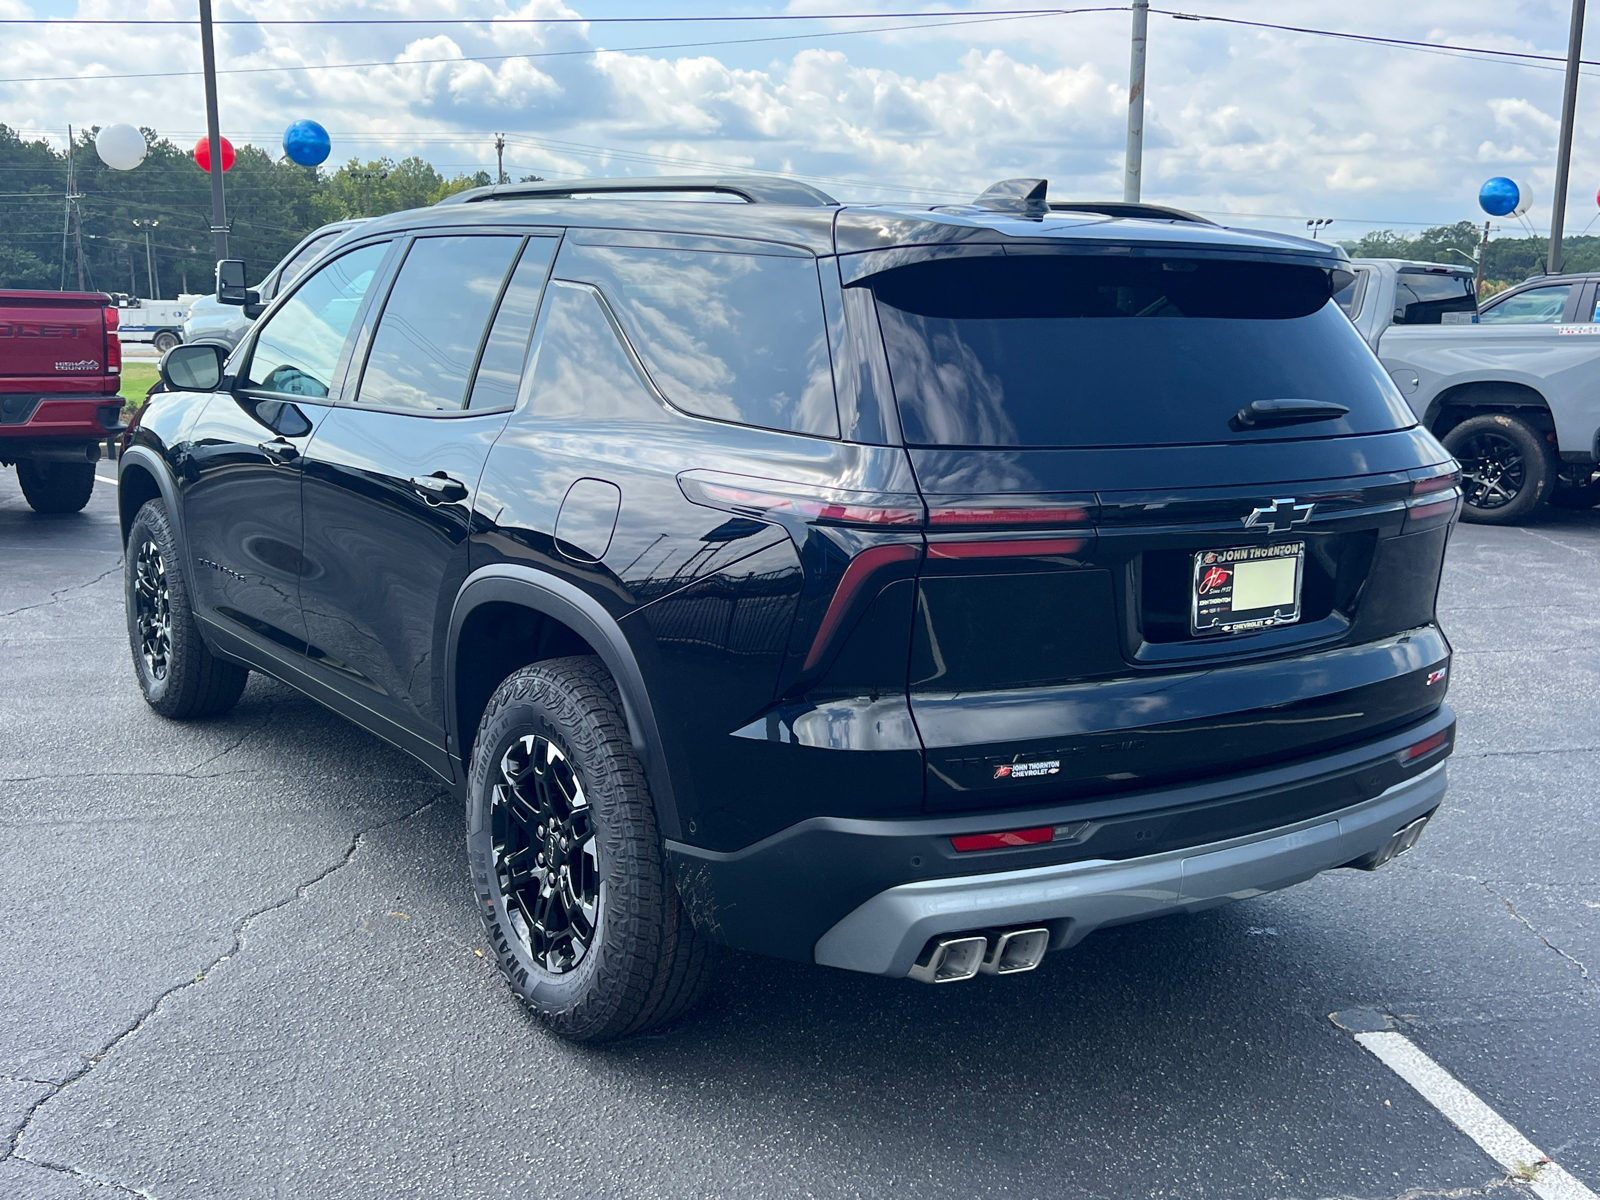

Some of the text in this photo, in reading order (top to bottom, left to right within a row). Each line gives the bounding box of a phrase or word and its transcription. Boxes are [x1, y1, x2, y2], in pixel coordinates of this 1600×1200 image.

[1221, 549, 1248, 562] JOHN
[1250, 544, 1298, 558] THORNTON
[1232, 620, 1264, 631] CHEVROLET
[1012, 760, 1060, 772] JOHN THORNTON
[1011, 768, 1048, 778] CHEVROLET
[473, 850, 529, 988] WRANGLER
